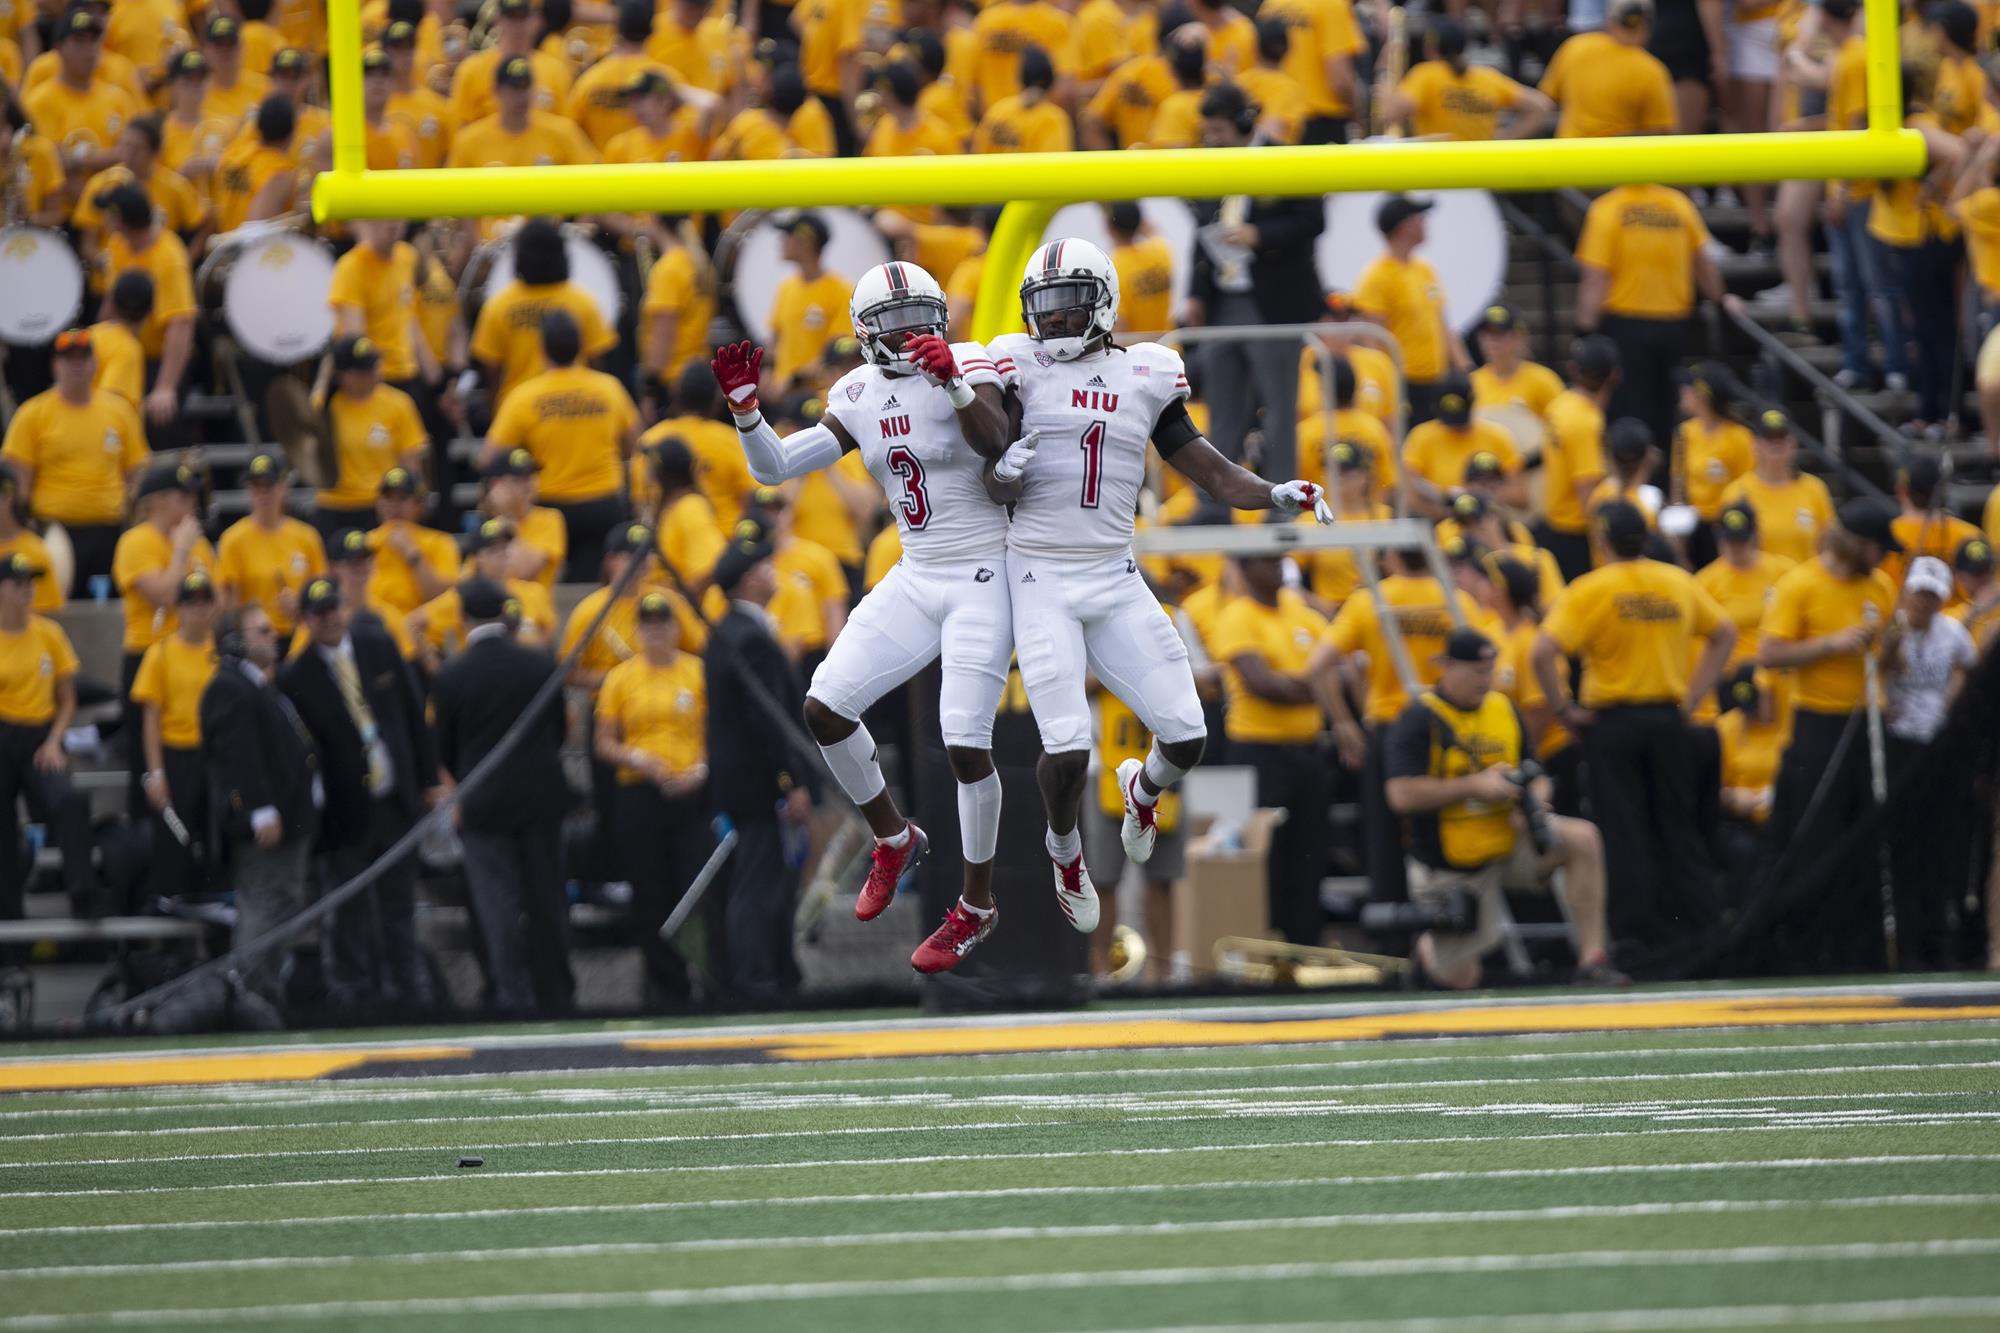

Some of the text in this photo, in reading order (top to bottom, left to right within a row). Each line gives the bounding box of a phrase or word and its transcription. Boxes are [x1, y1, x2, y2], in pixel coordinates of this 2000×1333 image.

[879, 414, 911, 439] NIU
[1071, 389, 1119, 412] NIU
[886, 445, 932, 531] 3
[1080, 420, 1106, 509] 1
